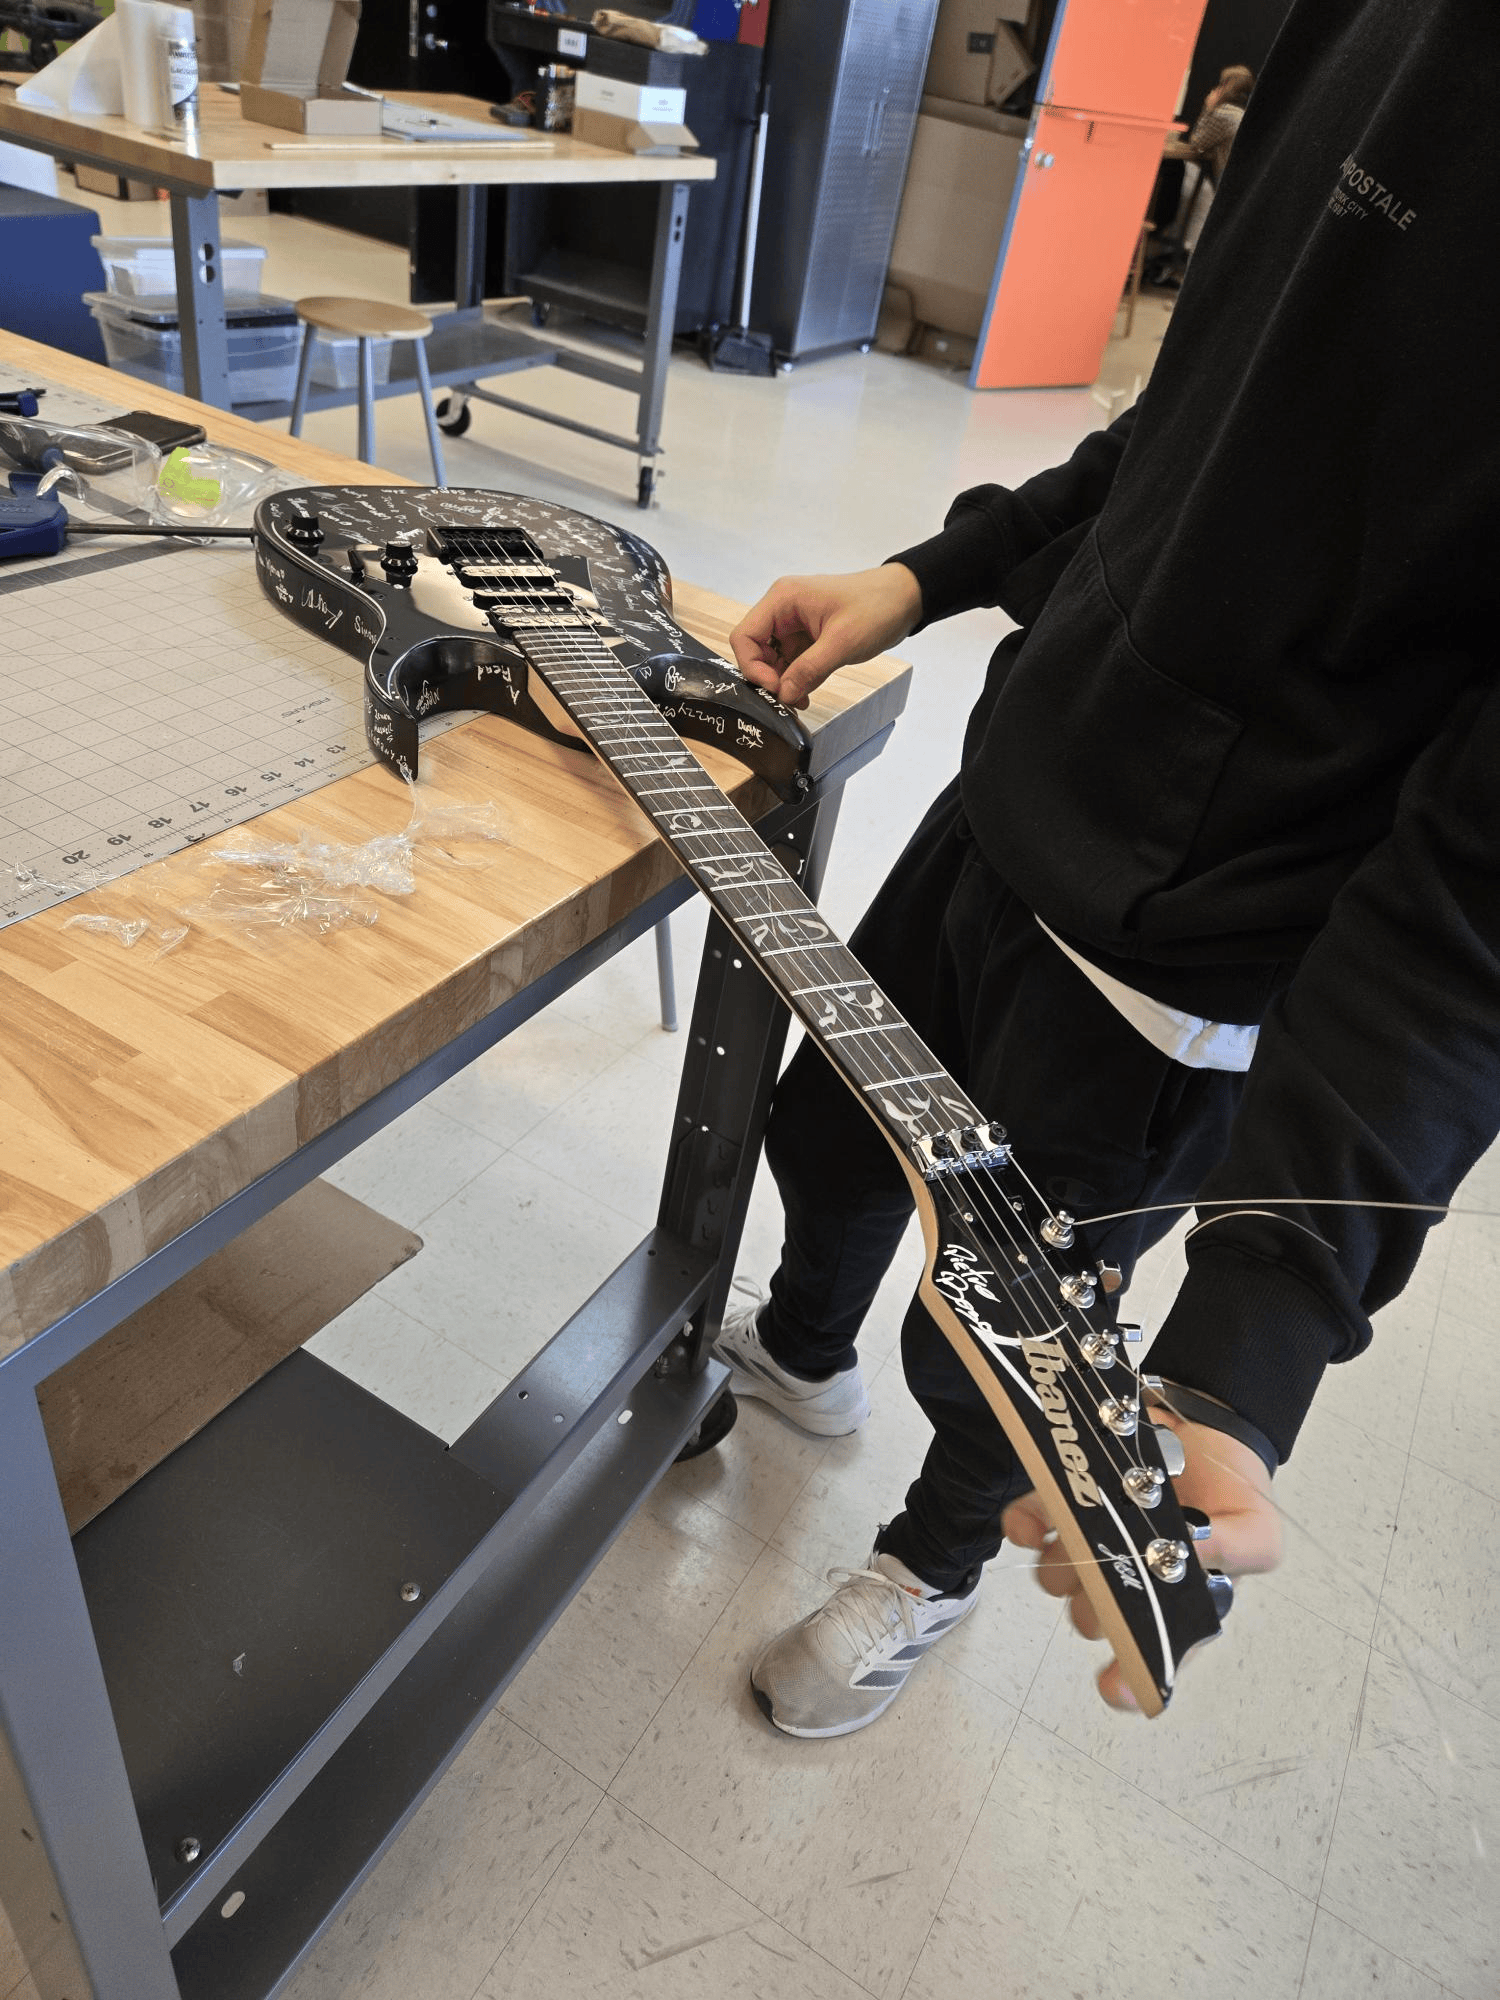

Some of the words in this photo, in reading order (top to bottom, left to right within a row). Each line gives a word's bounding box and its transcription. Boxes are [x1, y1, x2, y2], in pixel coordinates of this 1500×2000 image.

[1340, 154, 1417, 231] POSTALE
[1347, 201, 1369, 220] CITY
[281, 696, 331, 719] FISKARS
[678, 701, 725, 734] Buzzy
[326, 744, 347, 755] 13
[294, 757, 315, 769] 14
[260, 771, 282, 782] 15
[225, 785, 248, 797] 16
[189, 801, 210, 813] 17
[147, 816, 173, 829] 18
[106, 833, 132, 846] 19
[62, 849, 91, 865] 20
[1015, 1330, 1104, 1508] Ibanez
